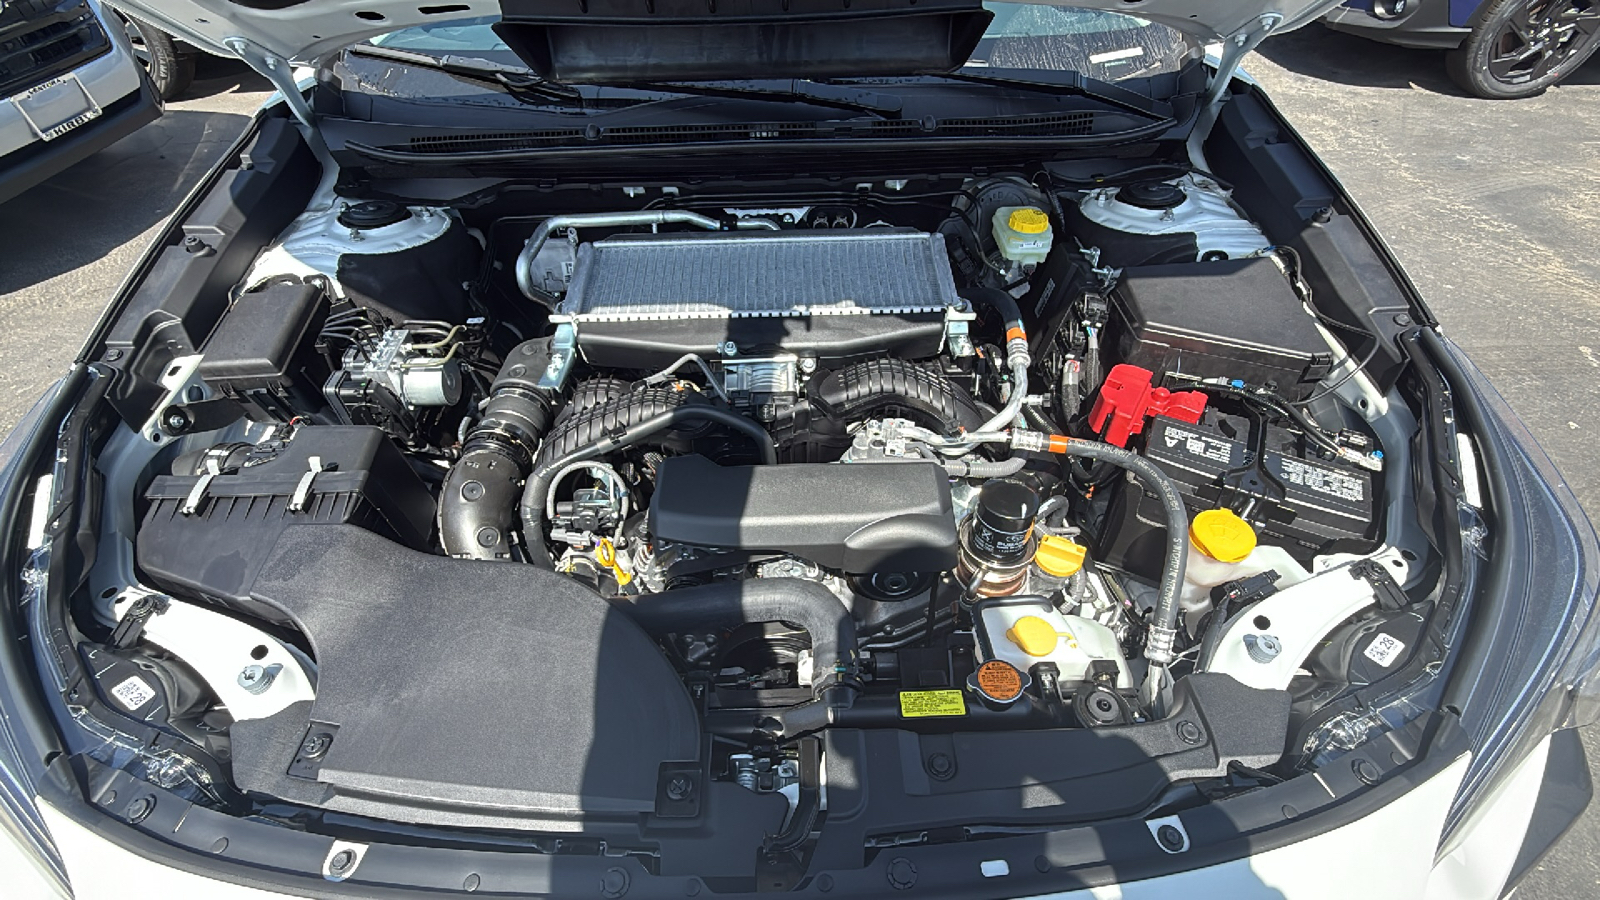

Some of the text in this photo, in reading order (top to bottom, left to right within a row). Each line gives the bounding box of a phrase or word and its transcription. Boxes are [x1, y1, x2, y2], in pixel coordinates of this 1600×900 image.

[53, 110, 94, 136] KIRBY
[1379, 636, 1395, 650] 28
[129, 692, 146, 706] 28
